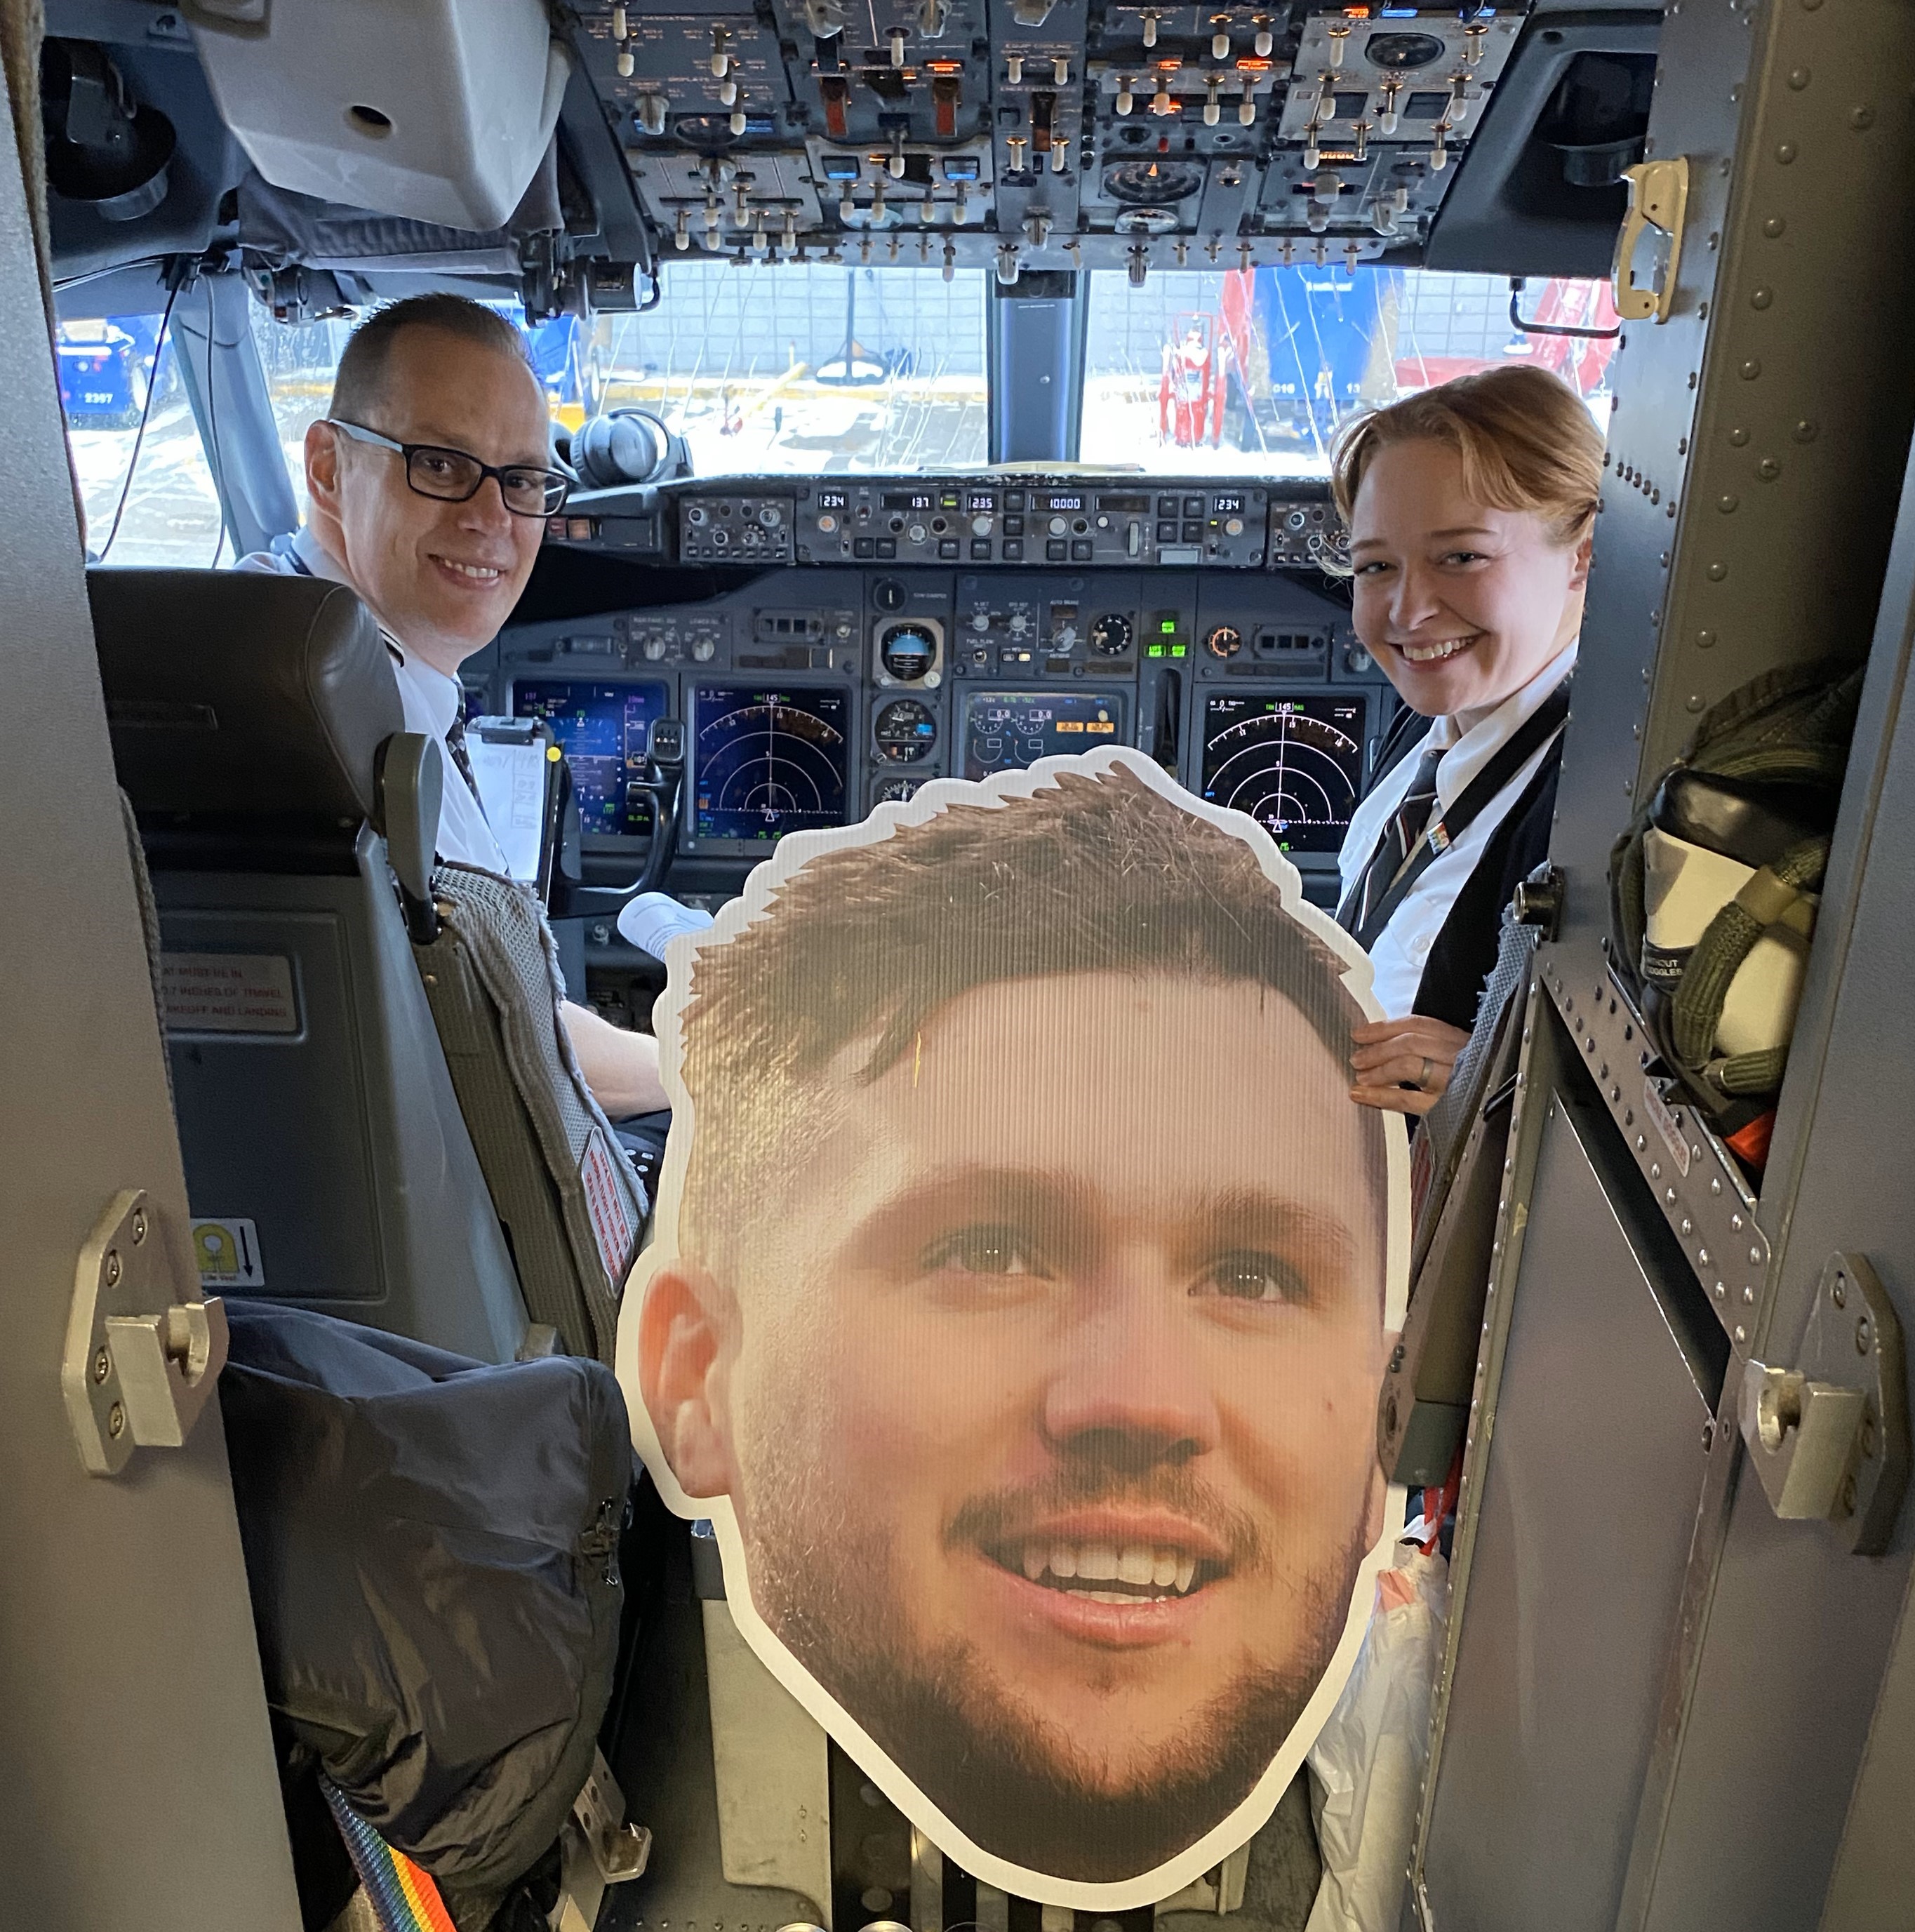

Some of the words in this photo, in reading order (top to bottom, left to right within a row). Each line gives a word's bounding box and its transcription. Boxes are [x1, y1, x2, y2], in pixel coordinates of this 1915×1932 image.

[823, 496, 844, 507] 234
[912, 497, 929, 507] 137
[972, 498, 993, 508] 235
[1050, 498, 1081, 509] 10000
[1218, 499, 1239, 510] 234
[997, 710, 1010, 718] 0.0
[1038, 710, 1052, 719] 0.0
[243, 988, 285, 998] TRAVEL
[239, 1007, 287, 1017] LANDING
